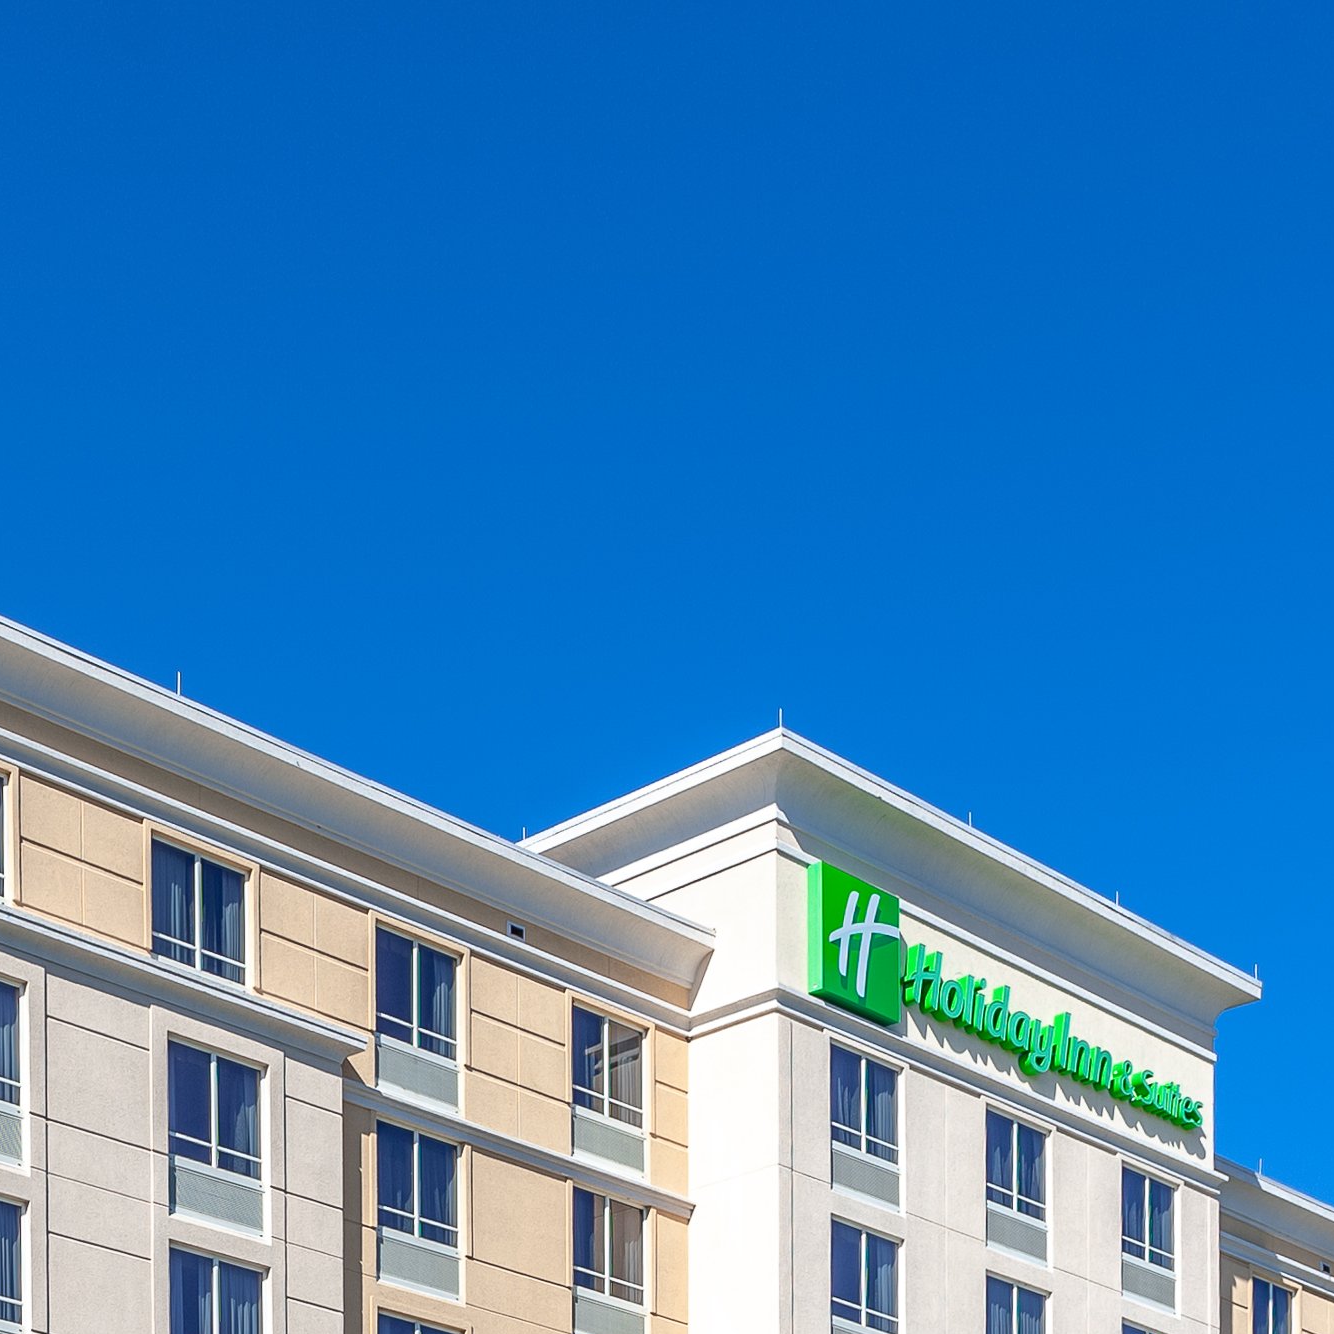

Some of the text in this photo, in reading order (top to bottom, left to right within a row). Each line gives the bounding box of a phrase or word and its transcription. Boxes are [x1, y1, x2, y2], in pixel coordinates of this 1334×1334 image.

[906, 943, 1204, 1128] Holiday Inn & Suites
